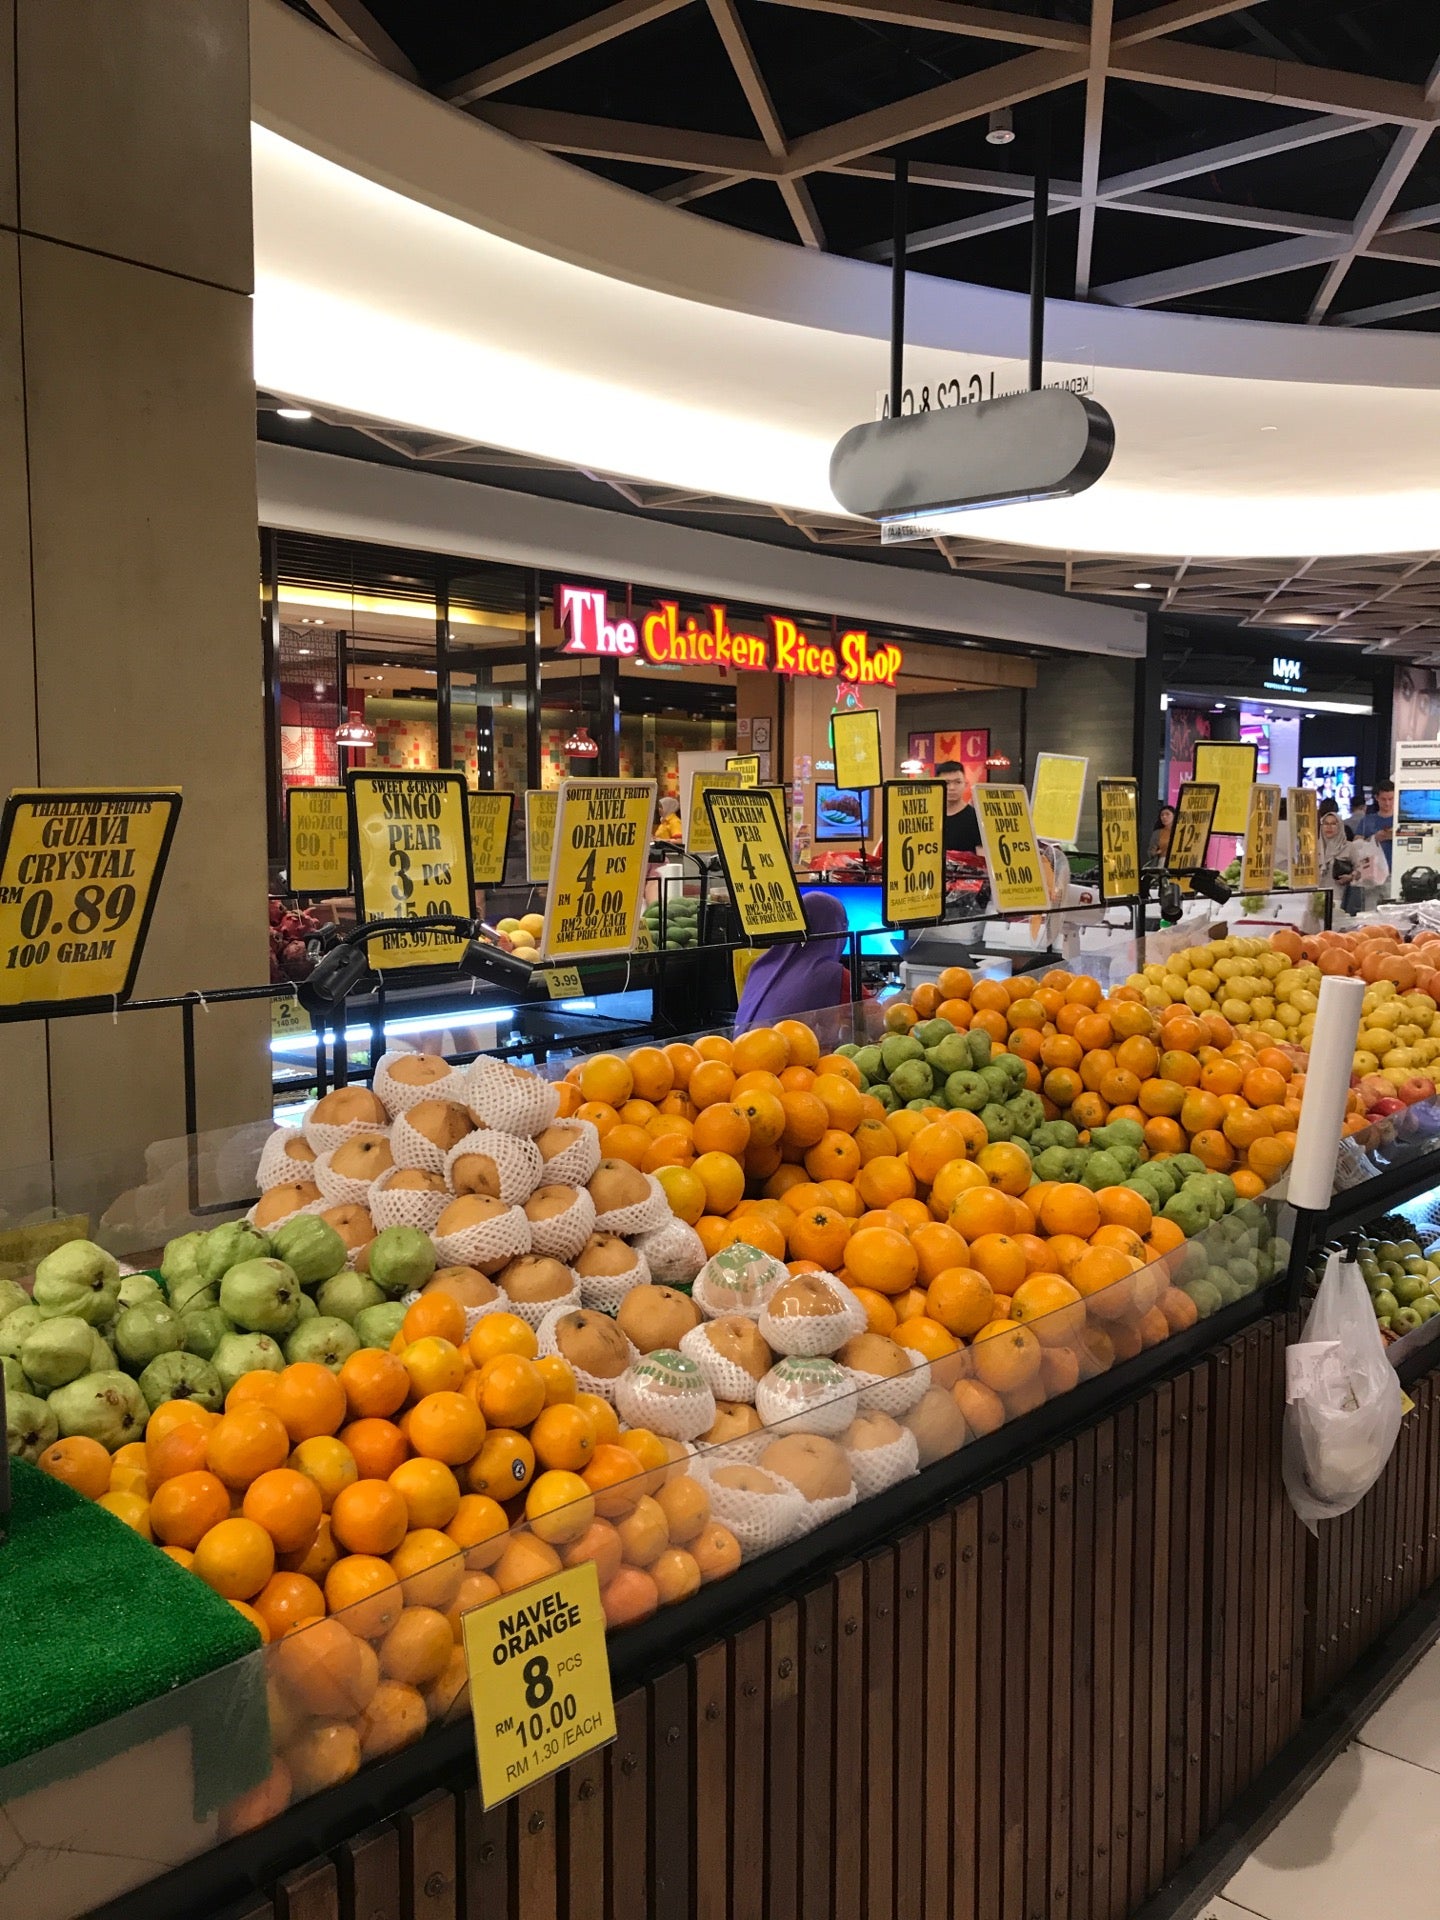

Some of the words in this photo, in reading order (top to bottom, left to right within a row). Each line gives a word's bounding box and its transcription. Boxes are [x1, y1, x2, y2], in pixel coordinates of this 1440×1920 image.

[562, 587, 637, 654] The
[643, 604, 766, 666] Chicken
[773, 617, 836, 677] Rice
[841, 632, 903, 684] Shop
[1272, 657, 1301, 680] NYX
[915, 739, 930, 760] T
[966, 735, 981, 758] C
[814, 759, 835, 770] chicke
[371, 779, 404, 794] SWEET
[566, 788, 593, 802] SOUTH
[593, 787, 622, 800] AFRICA
[623, 786, 651, 799] FRUITS
[31, 801, 102, 817] THAILAND
[105, 800, 153, 816] FRUITS
[381, 792, 442, 820] SINGO
[586, 799, 626, 821] NAVEL
[718, 806, 767, 824] PACKHAM
[902, 798, 929, 817] NAVEL
[983, 801, 1003, 817] PINK
[1002, 801, 1024, 817] LADY
[41, 815, 130, 849] GUAVA
[387, 823, 442, 851] PEAR
[571, 822, 637, 850] ORANGE
[733, 825, 763, 843] PEAR
[897, 815, 934, 835] ORANGE
[994, 818, 1020, 833] APPLE
[1105, 822, 1123, 853] 12
[997, 834, 1012, 867] 6
[1011, 841, 1031, 852] PCS
[1175, 825, 1196, 853] 12
[17, 848, 137, 885] CRYSTAL
[740, 842, 758, 880] 4
[758, 853, 775, 868] PCS
[901, 835, 915, 873] 6
[917, 842, 939, 856] PCS
[388, 850, 414, 901] 3
[421, 862, 452, 886] PCS
[576, 848, 597, 893] 4
[605, 856, 627, 874] PCS
[889, 880, 899, 891] RM
[903, 869, 935, 894] 10.00
[1005, 866, 1033, 885] 10.00
[557, 893, 571, 907] RM
[575, 889, 624, 918] 10.00
[734, 881, 745, 893] RM
[749, 881, 785, 904] 10.00
[0, 886, 25, 905] RM
[20, 883, 137, 940] 0.89
[393, 900, 453, 919] 1500
[744, 900, 794, 916] RM2.99/EACH
[759, 913, 777, 925] PRICE
[556, 930, 575, 944] SAME
[576, 928, 598, 942] PRICE
[599, 927, 613, 939] CAN
[613, 925, 627, 937] MIX
[560, 911, 627, 933] RM2.99/EACH
[5, 940, 51, 970] 100
[56, 939, 117, 964] GRAM
[551, 974, 578, 987] 3.99
[279, 1003, 291, 1019] 2
[498, 1591, 569, 1640] NAVEL
[492, 1604, 582, 1666] ORANGE
[522, 1655, 554, 1710] 8
[556, 1652, 583, 1678] PCS
[495, 1716, 514, 1738] RM
[515, 1693, 577, 1749] 10.00
[505, 1758, 529, 1783] RM
[532, 1737, 560, 1765] 1.30
[562, 1711, 603, 1750] /EACH
